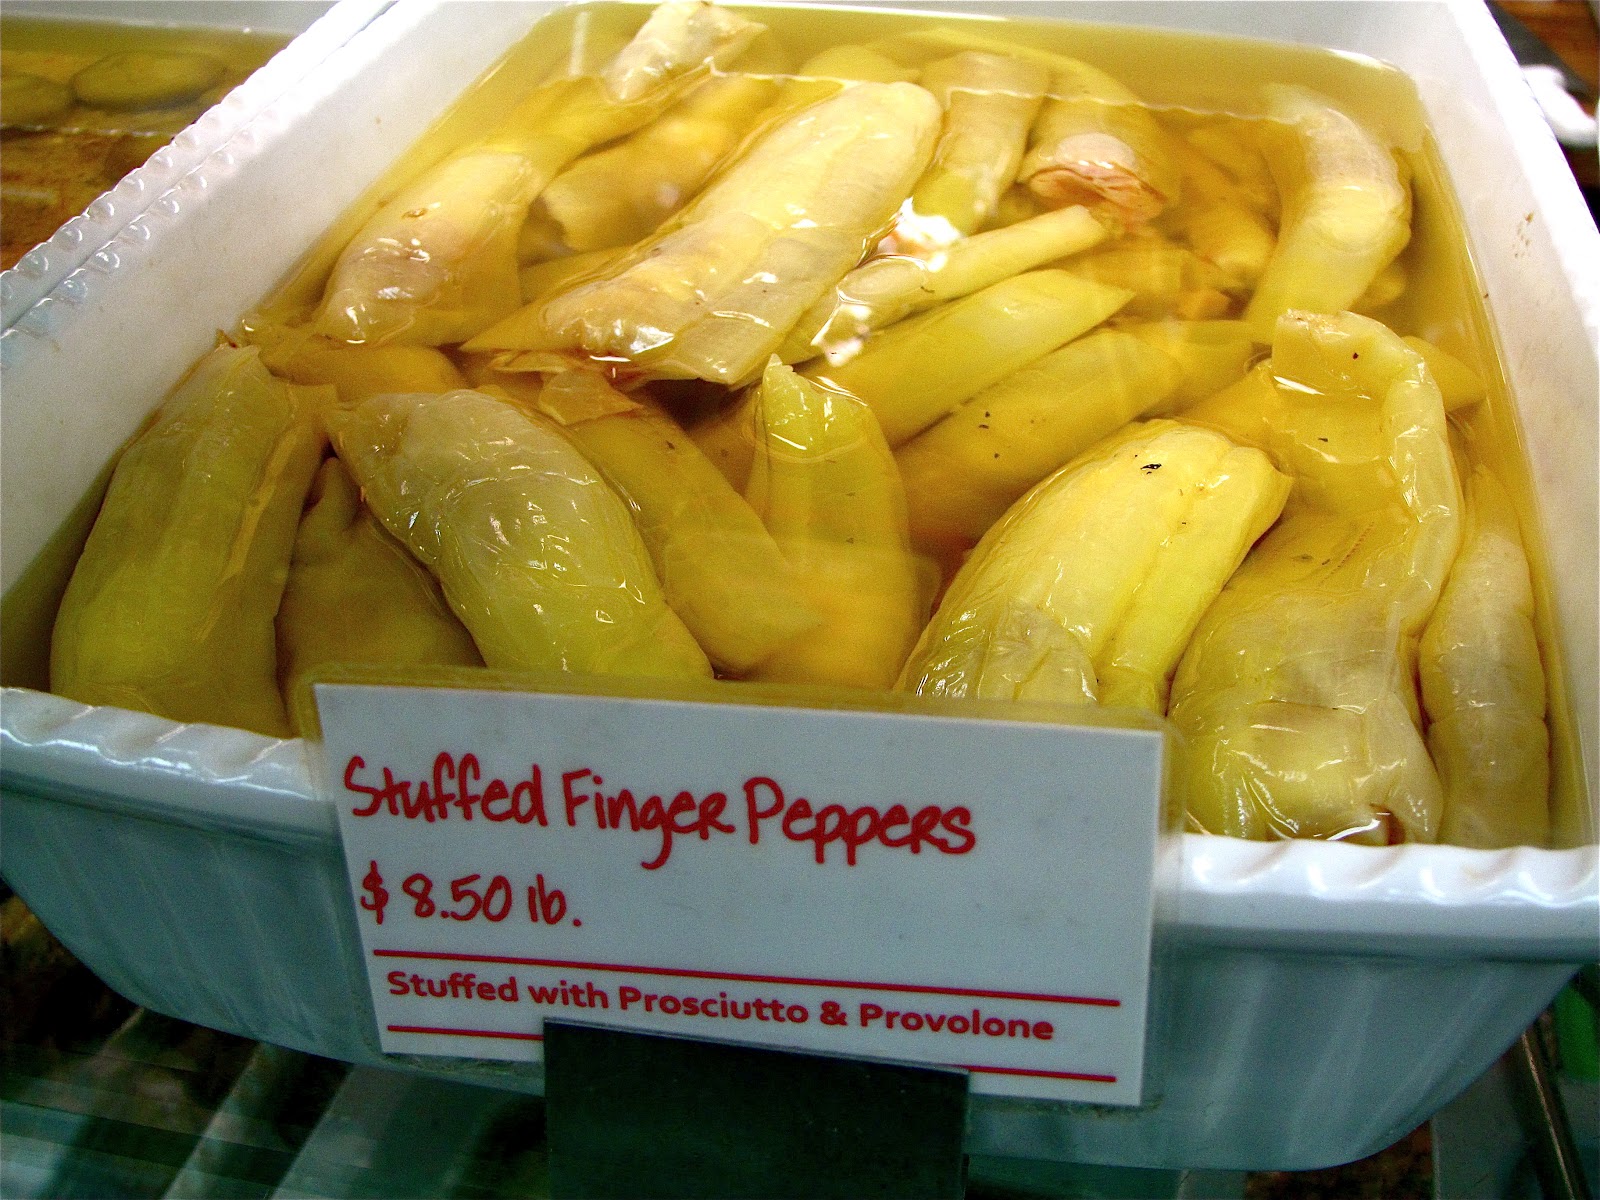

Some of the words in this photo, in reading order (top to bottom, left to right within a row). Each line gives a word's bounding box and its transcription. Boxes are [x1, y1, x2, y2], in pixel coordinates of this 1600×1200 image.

[342, 751, 549, 827] Stuffed
[527, 874, 582, 927] lb.
[387, 971, 519, 1002] Stuffed
[527, 982, 609, 1009] with
[619, 986, 809, 1023] Prosciutto
[819, 1001, 848, 1026] &
[859, 1004, 1054, 1041] Provolone
